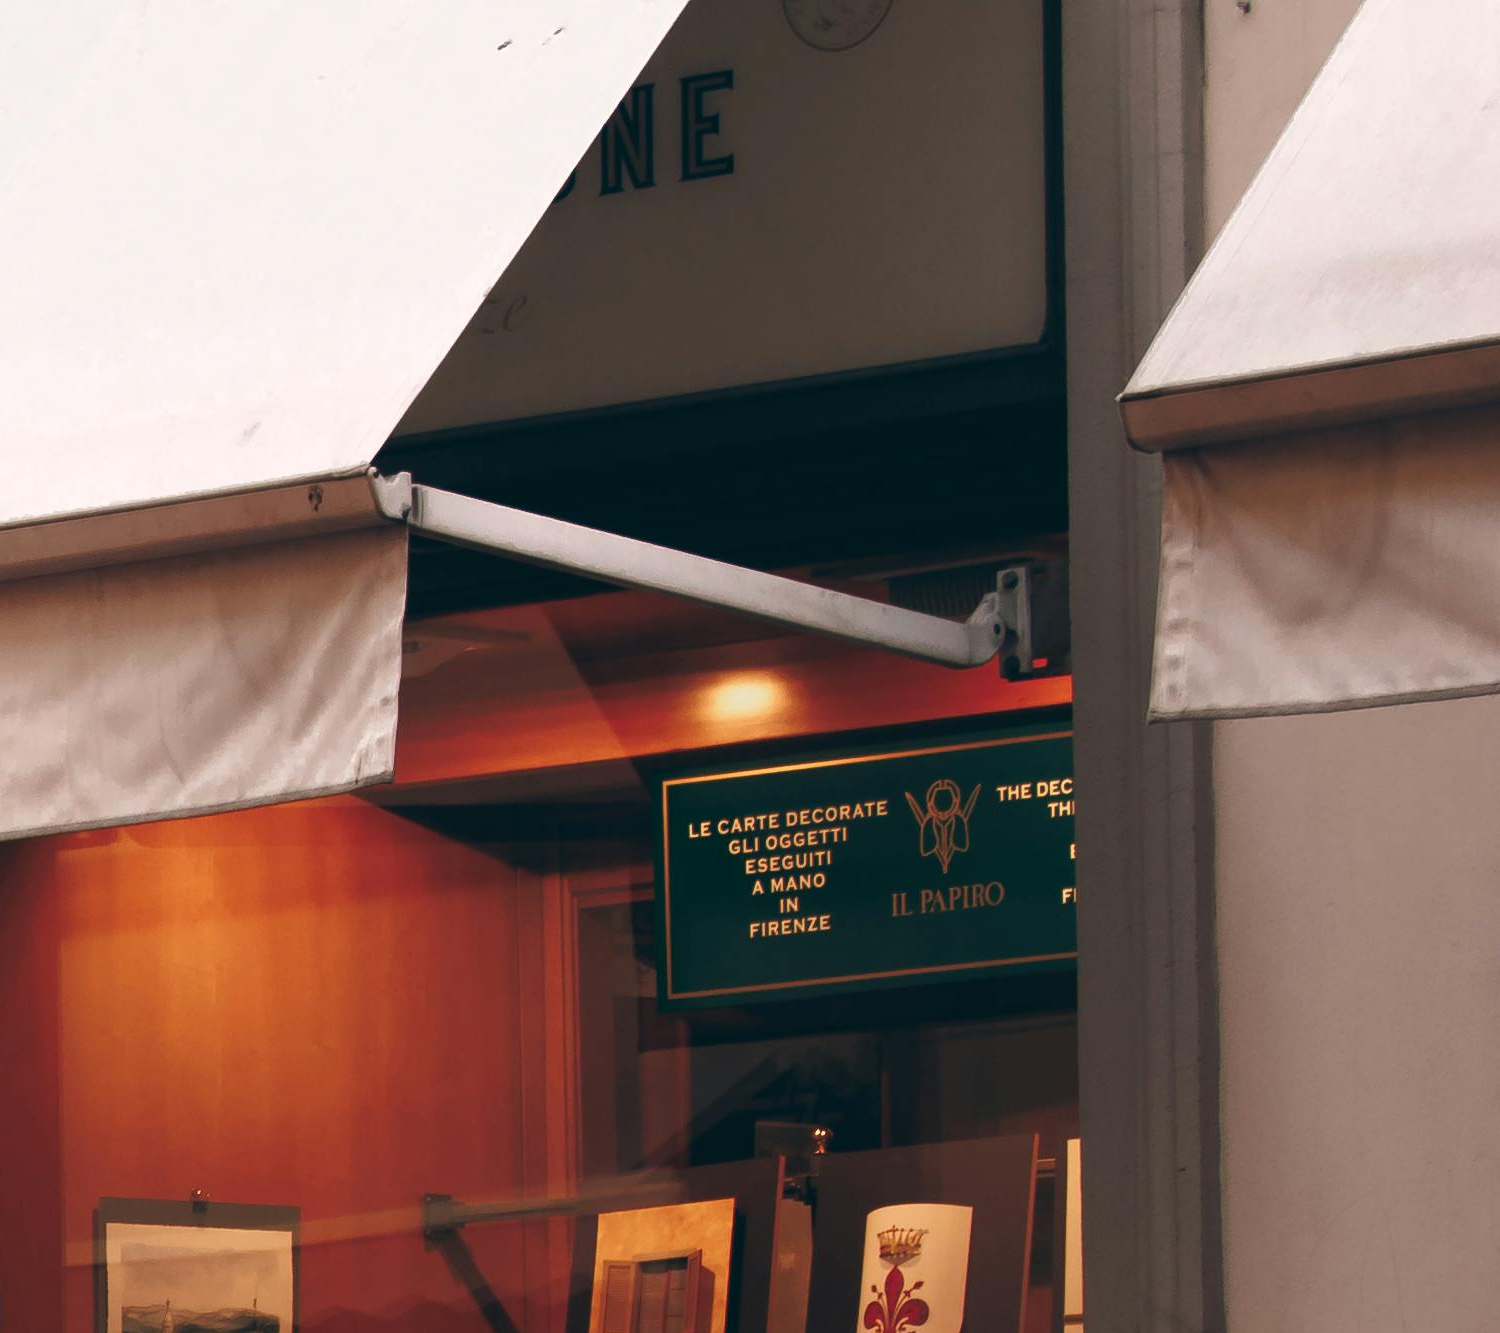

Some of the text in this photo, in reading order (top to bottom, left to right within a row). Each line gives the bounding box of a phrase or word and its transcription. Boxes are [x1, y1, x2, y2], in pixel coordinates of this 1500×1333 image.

[552, 69, 735, 203] NE
[996, 777, 1074, 802] THE DEC
[688, 799, 889, 838] LE CARTE DECORATE
[728, 826, 848, 855] GLI OGGETTI
[745, 849, 833, 875] ESEGUITI
[751, 873, 827, 896] A MANO
[779, 896, 799, 914] IN
[891, 880, 1006, 918] IL PAPIRO
[748, 914, 832, 939] FIRENZE
